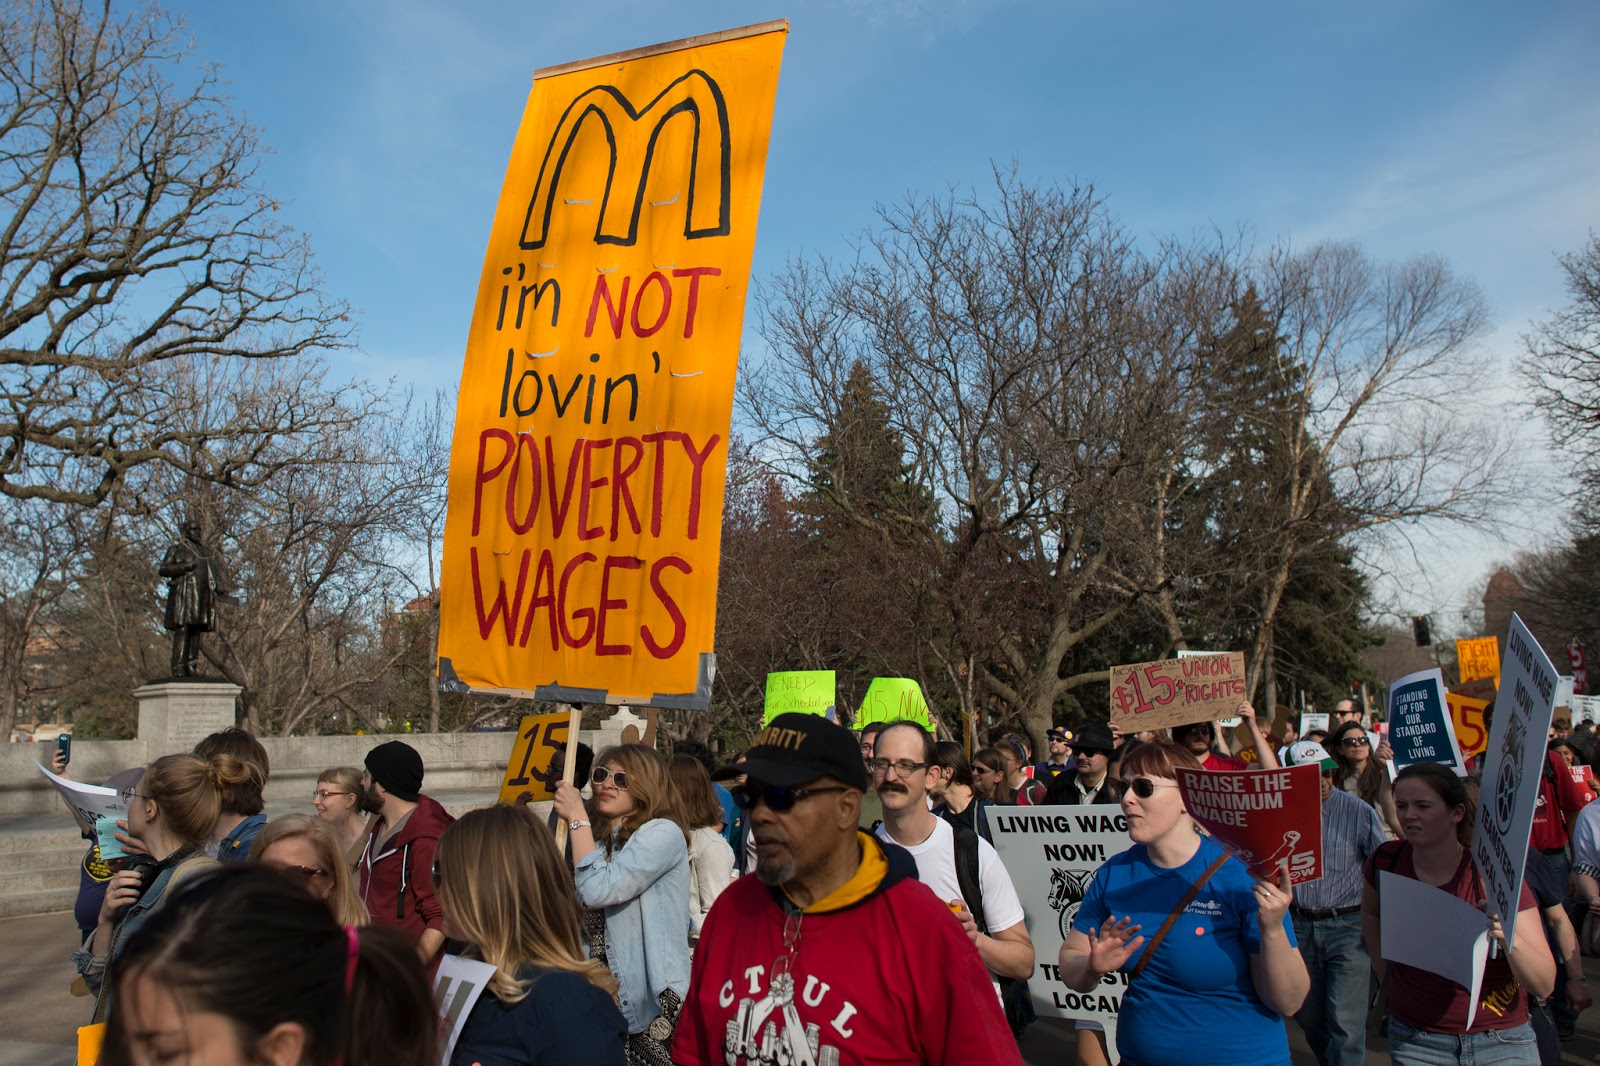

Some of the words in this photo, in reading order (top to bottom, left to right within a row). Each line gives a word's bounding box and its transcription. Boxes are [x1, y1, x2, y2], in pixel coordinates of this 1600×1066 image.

[496, 263, 561, 331] i'm
[584, 267, 721, 339] NOT
[499, 348, 660, 424] lovin'
[471, 428, 720, 542] POVERTY
[471, 547, 692, 659] WAGES
[1459, 641, 1496, 657] FIGHT
[1467, 660, 1493, 673] FOR
[1510, 628, 1532, 674] LIVING
[1532, 659, 1552, 706] WAGE
[781, 675, 815, 693] NEED
[1112, 665, 1176, 714] $15
[1182, 657, 1232, 678] UNION
[1186, 679, 1245, 703] RIGHTS
[1396, 689, 1428, 706] STANDING
[1400, 704, 1408, 715] UP
[1410, 701, 1425, 713] FOR
[1514, 678, 1534, 722] NOW!
[1395, 722, 1437, 738] STANDARD
[1405, 713, 1421, 725] OUR
[1408, 746, 1436, 759] LIVING
[1413, 736, 1423, 747] OF
[507, 721, 570, 786] 15
[1184, 773, 1246, 793] RAISE
[1250, 772, 1292, 793] THE
[1187, 789, 1283, 811] MINIMUM
[997, 816, 1071, 833] LIVING
[1075, 815, 1129, 833] WAG
[1190, 803, 1248, 827] WAGE
[1044, 844, 1107, 862] NOW!
[1482, 803, 1516, 892] TEAMSTERS
[1477, 838, 1497, 894] LOCAL
